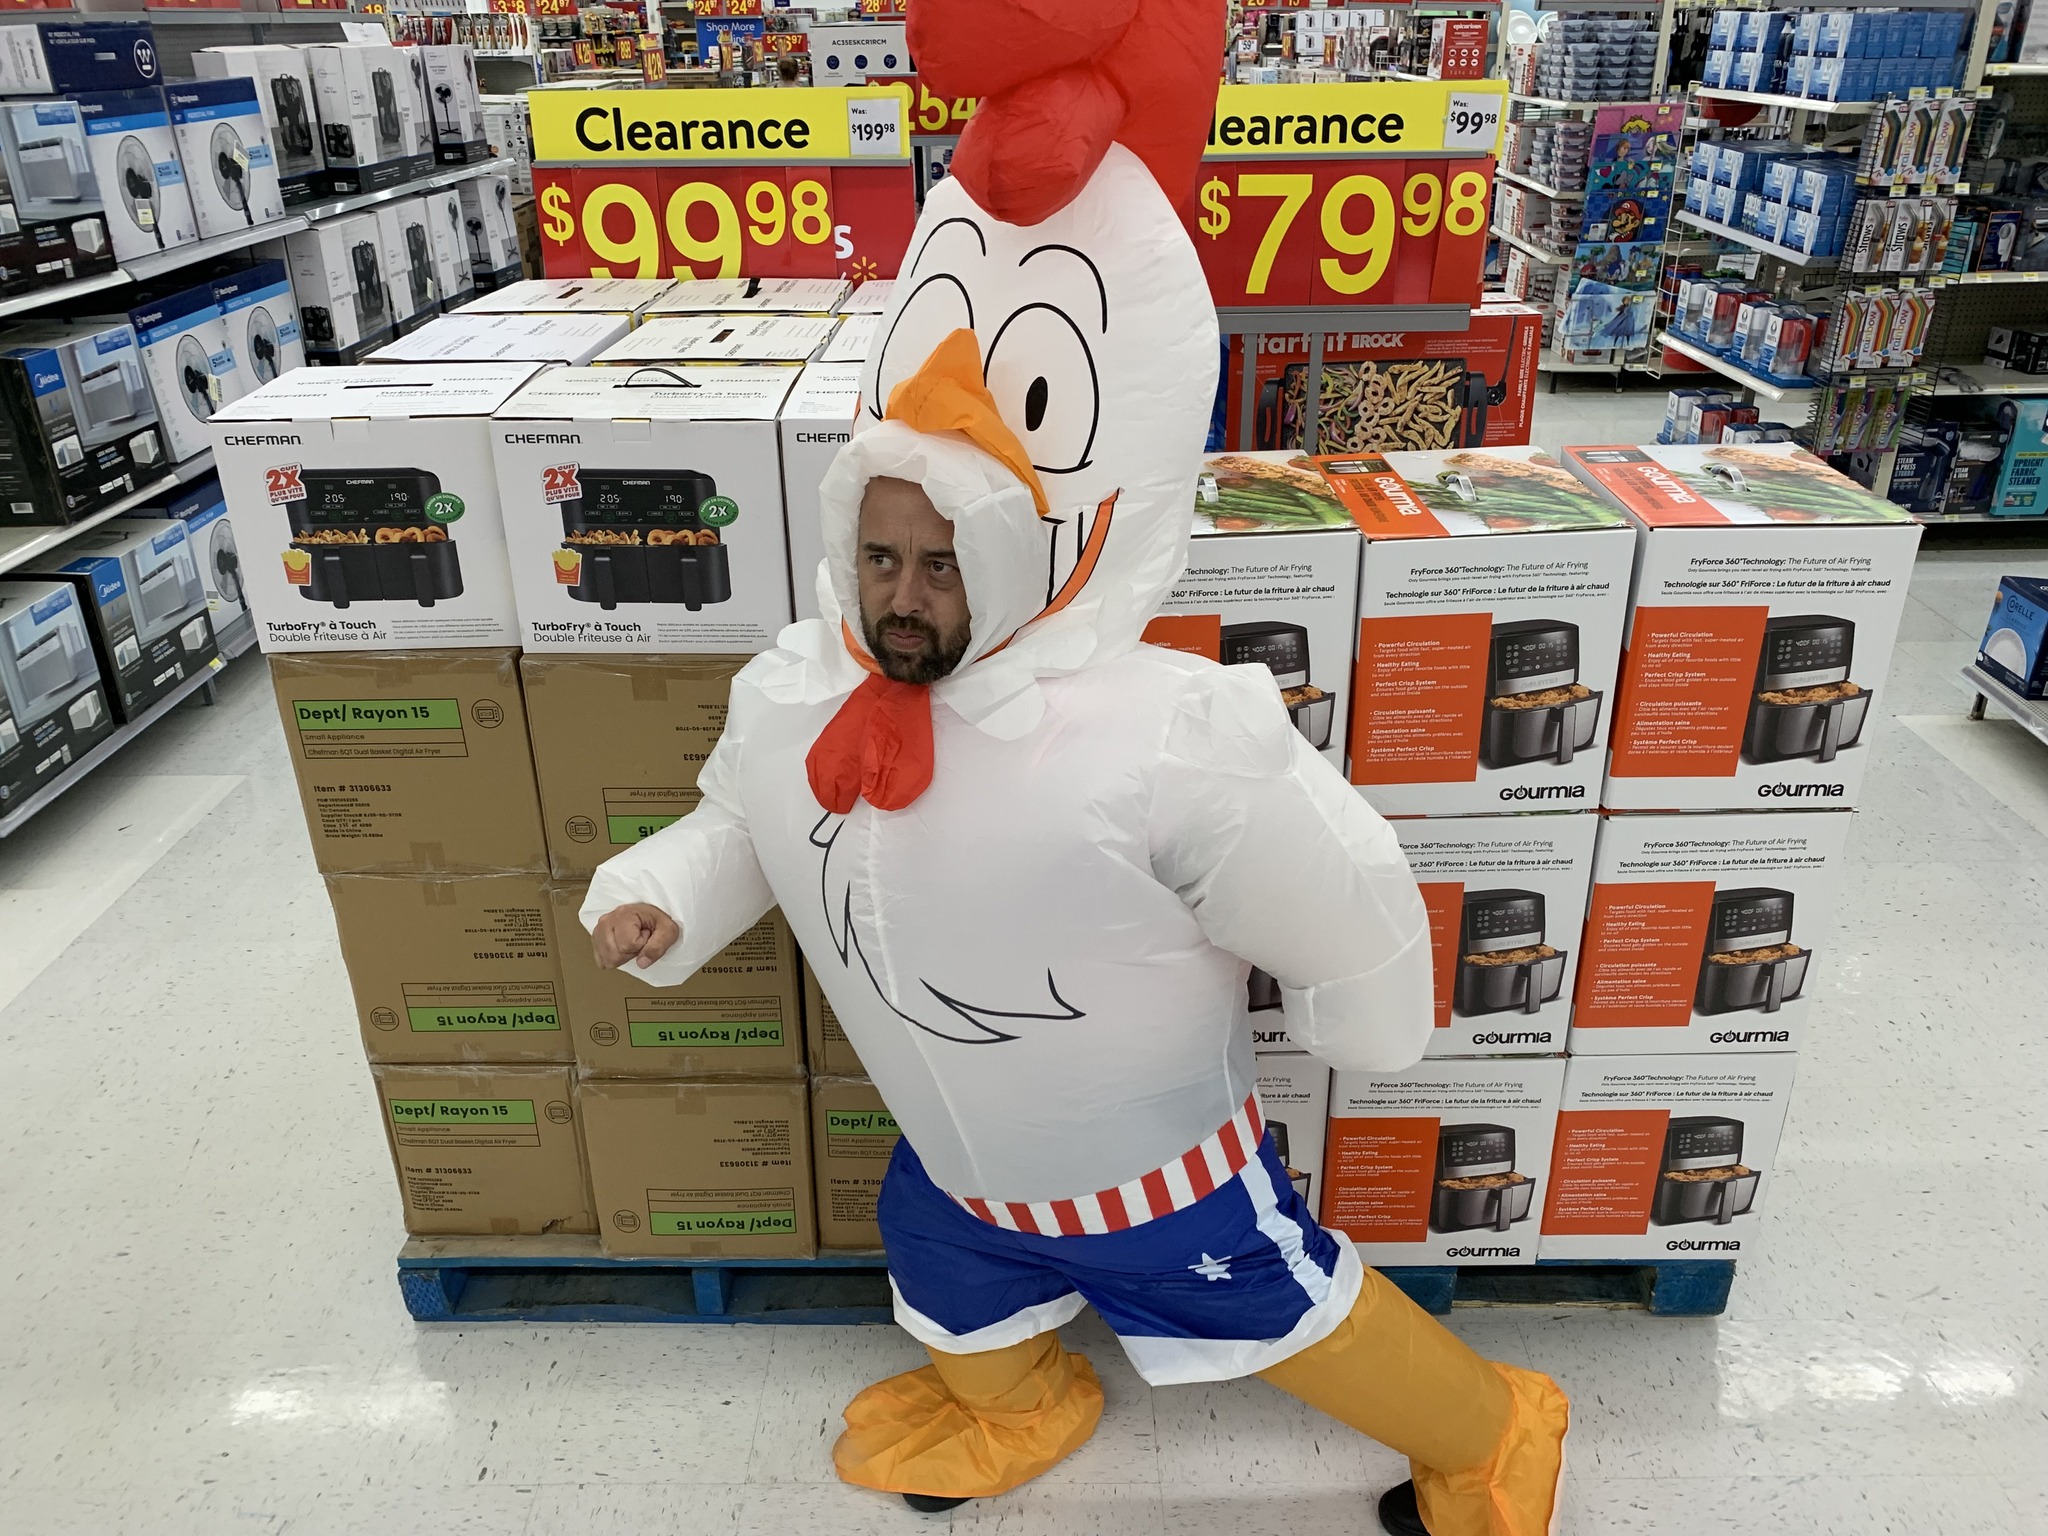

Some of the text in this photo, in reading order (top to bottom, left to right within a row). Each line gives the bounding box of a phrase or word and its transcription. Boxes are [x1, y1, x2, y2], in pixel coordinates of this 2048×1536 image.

[706, 22, 755, 34] Shop More
[576, 106, 810, 151] Clearance
[1207, 108, 1404, 147] learance
[1858, 224, 1874, 253] Straws
[1891, 222, 1907, 252] Straws
[1863, 310, 1877, 353] rainbow
[1892, 309, 1908, 351] rainbow
[1240, 332, 1406, 354] tarfit ROCK
[224, 435, 301, 446] CHEFMAN
[505, 433, 581, 444] CHEFMAN
[796, 432, 851, 443] CHEFM
[2013, 459, 2045, 468] UPRIGHT
[2011, 468, 2036, 477] FABRIC
[266, 469, 302, 492] 2X
[543, 468, 579, 491] 2X
[1637, 467, 1696, 504] Gourmia
[2008, 477, 2041, 486] STEAMER
[270, 487, 303, 498] PLUS VITE
[546, 486, 579, 497] PLUS VITE
[1374, 477, 1422, 516] Gourmia
[434, 502, 454, 515] 2X
[709, 505, 728, 518] 2X
[1690, 558, 1723, 567] FryForce
[1803, 557, 1826, 565] Future
[1837, 557, 1848, 565] Air
[1849, 557, 1872, 566] Frying
[1410, 567, 1443, 577] FryForce
[1507, 564, 1521, 572] The
[1526, 563, 1545, 571] Future
[1555, 562, 1565, 570] Air
[1567, 561, 1588, 571] Frying
[1386, 590, 1429, 599] Technologie
[1508, 586, 1526, 594] futur
[1528, 585, 1537, 593] de
[1546, 584, 1569, 592] friture
[1576, 583, 1586, 591] air
[1587, 582, 1610, 590] chaud
[1664, 580, 1707, 589] Technologie
[1776, 580, 1786, 588] Le
[1787, 580, 1805, 588] futur
[1807, 580, 1817, 588] de
[1826, 580, 1849, 588] friture
[1856, 580, 1866, 588] air
[1868, 579, 1891, 588] chaud
[2007, 595, 2034, 621] CORELLE
[329, 620, 337, 630] à
[339, 620, 376, 630] Touch
[594, 621, 602, 631] à
[604, 622, 641, 631] Touch
[270, 630, 387, 642] Double Friteuse à Air
[533, 633, 575, 642] Double
[578, 632, 622, 643] Friteuse
[625, 633, 633, 642] à
[637, 633, 651, 642] Air
[1651, 631, 1678, 639] Powerful
[1648, 652, 1691, 660] Healthy Eating
[1668, 671, 1683, 679] Crisp
[1684, 671, 1706, 679] System
[299, 704, 430, 723] Dept/ Rayon 15
[304, 733, 365, 744] Small Appliance
[1682, 738, 1697, 746] Crisp
[314, 784, 336, 792] Item
[349, 784, 392, 793] 31306633
[1500, 785, 1585, 801] Gourmia
[1757, 782, 1844, 798] Gourmia
[527, 950, 548, 959] Item
[437, 1012, 557, 1029] Dept/ Rayon 15
[658, 1027, 780, 1044] Dept/ Rayon 15
[1472, 1031, 1552, 1045] Gourmia
[1710, 1030, 1790, 1043] Gourmia
[394, 1103, 509, 1119] Dept/ Rayon 15
[830, 1114, 873, 1129] Dept/
[677, 1216, 792, 1232] Dept/ Rayon 15
[1666, 1238, 1741, 1251] Gourmia
[1446, 1246, 1521, 1257] Gourmia
